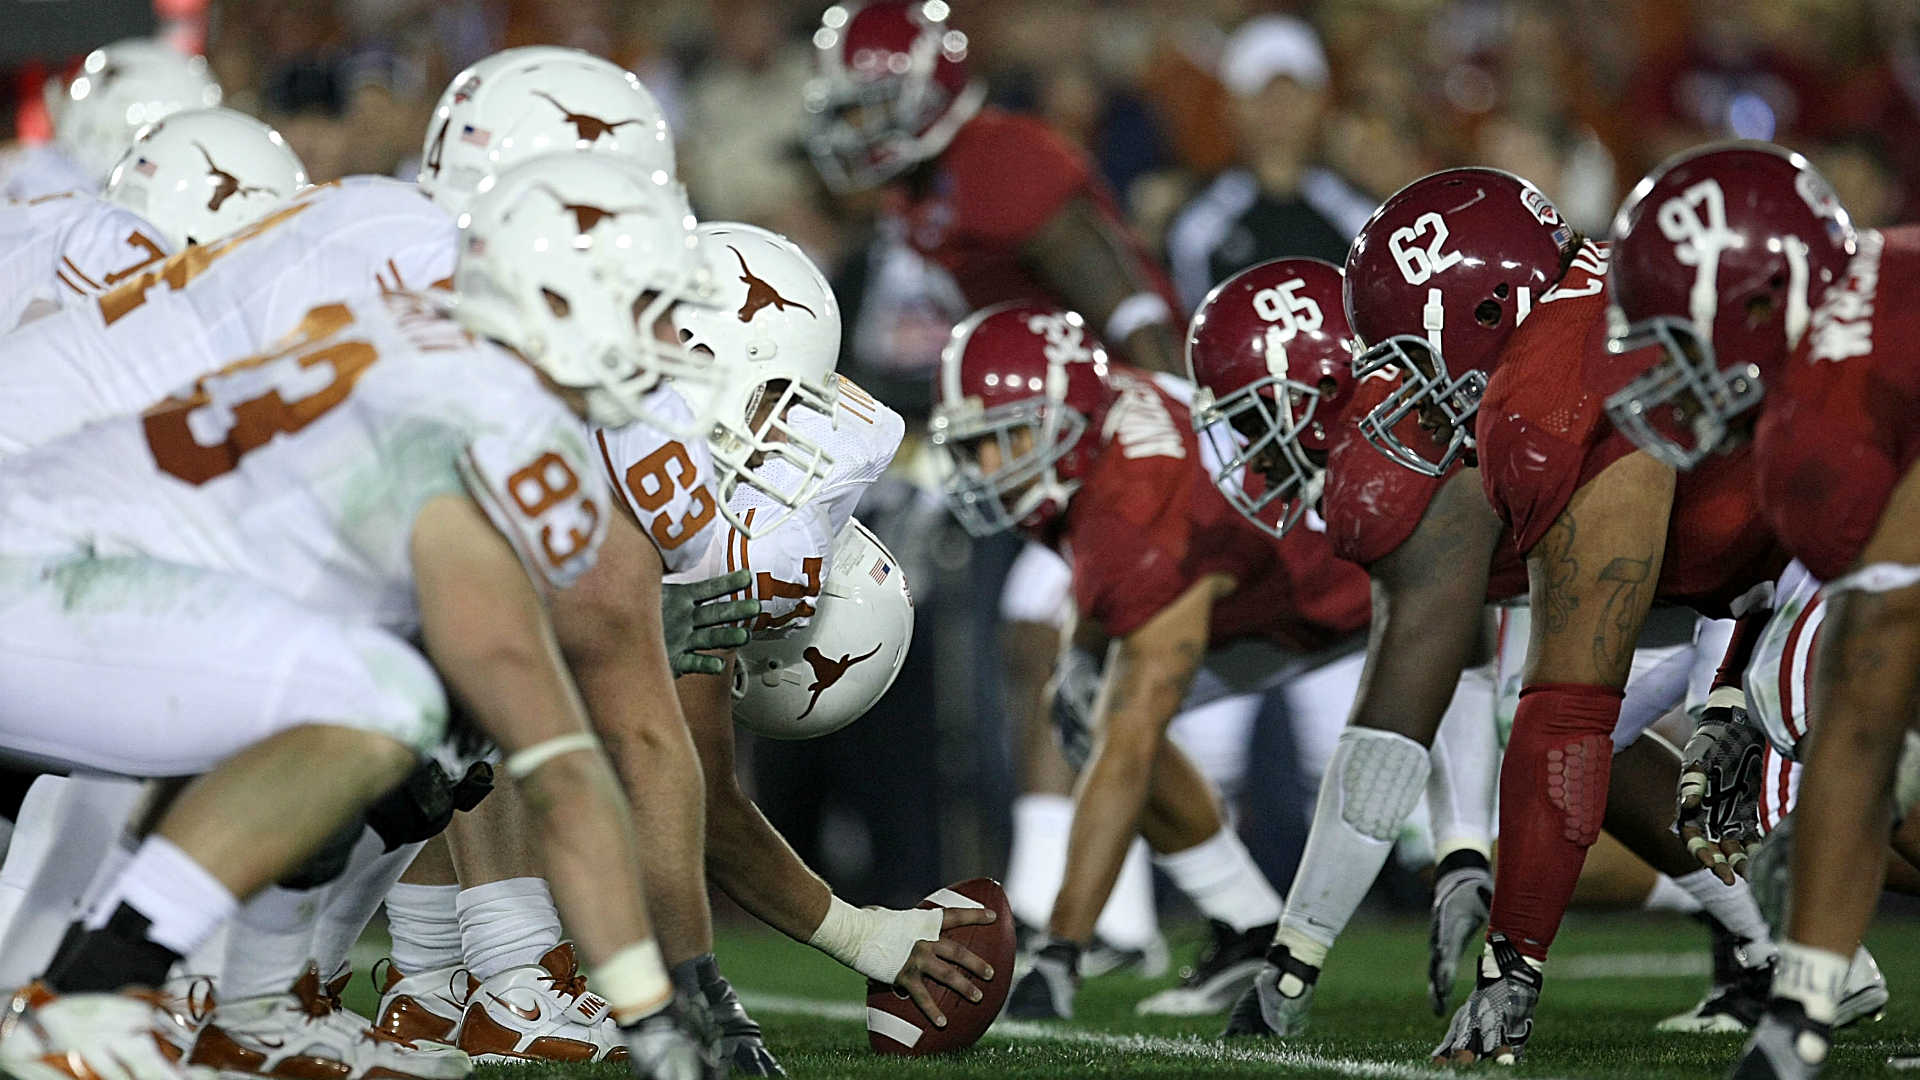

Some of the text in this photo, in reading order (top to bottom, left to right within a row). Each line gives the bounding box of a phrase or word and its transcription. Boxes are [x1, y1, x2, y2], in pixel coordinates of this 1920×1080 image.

[1388, 211, 1463, 286] 62
[1657, 177, 1730, 267] 97
[1252, 277, 1324, 344] 95
[507, 451, 600, 568] 83
[625, 439, 717, 550] 63
[576, 994, 608, 1020] NIKE
